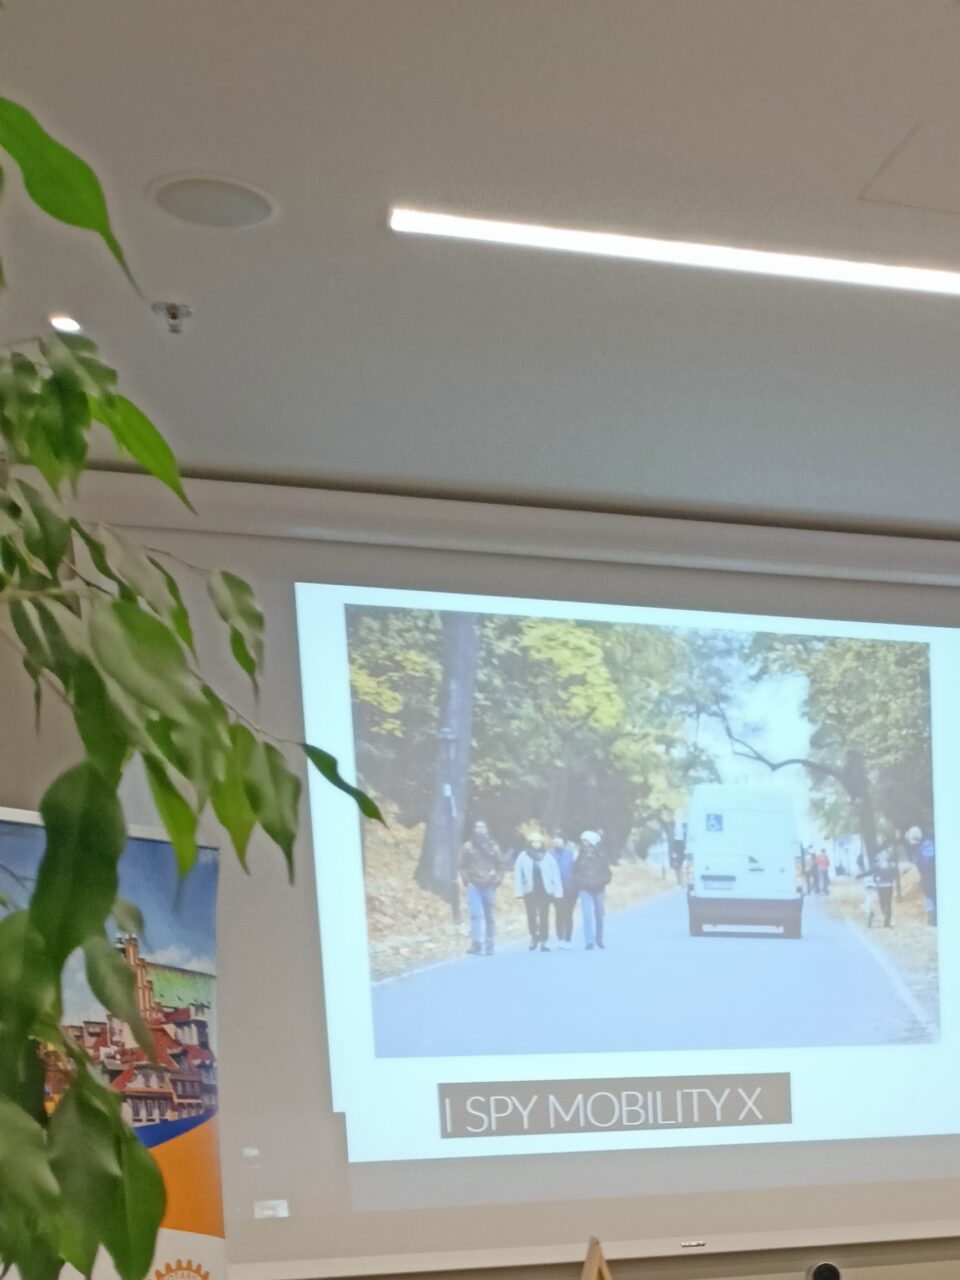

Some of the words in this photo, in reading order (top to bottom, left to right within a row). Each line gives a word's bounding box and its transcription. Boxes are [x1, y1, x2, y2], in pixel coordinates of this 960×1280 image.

[444, 1097, 453, 1133] I
[465, 1094, 538, 1133] SPY
[548, 1087, 731, 1129] MOBILITY
[737, 1086, 764, 1121] X
